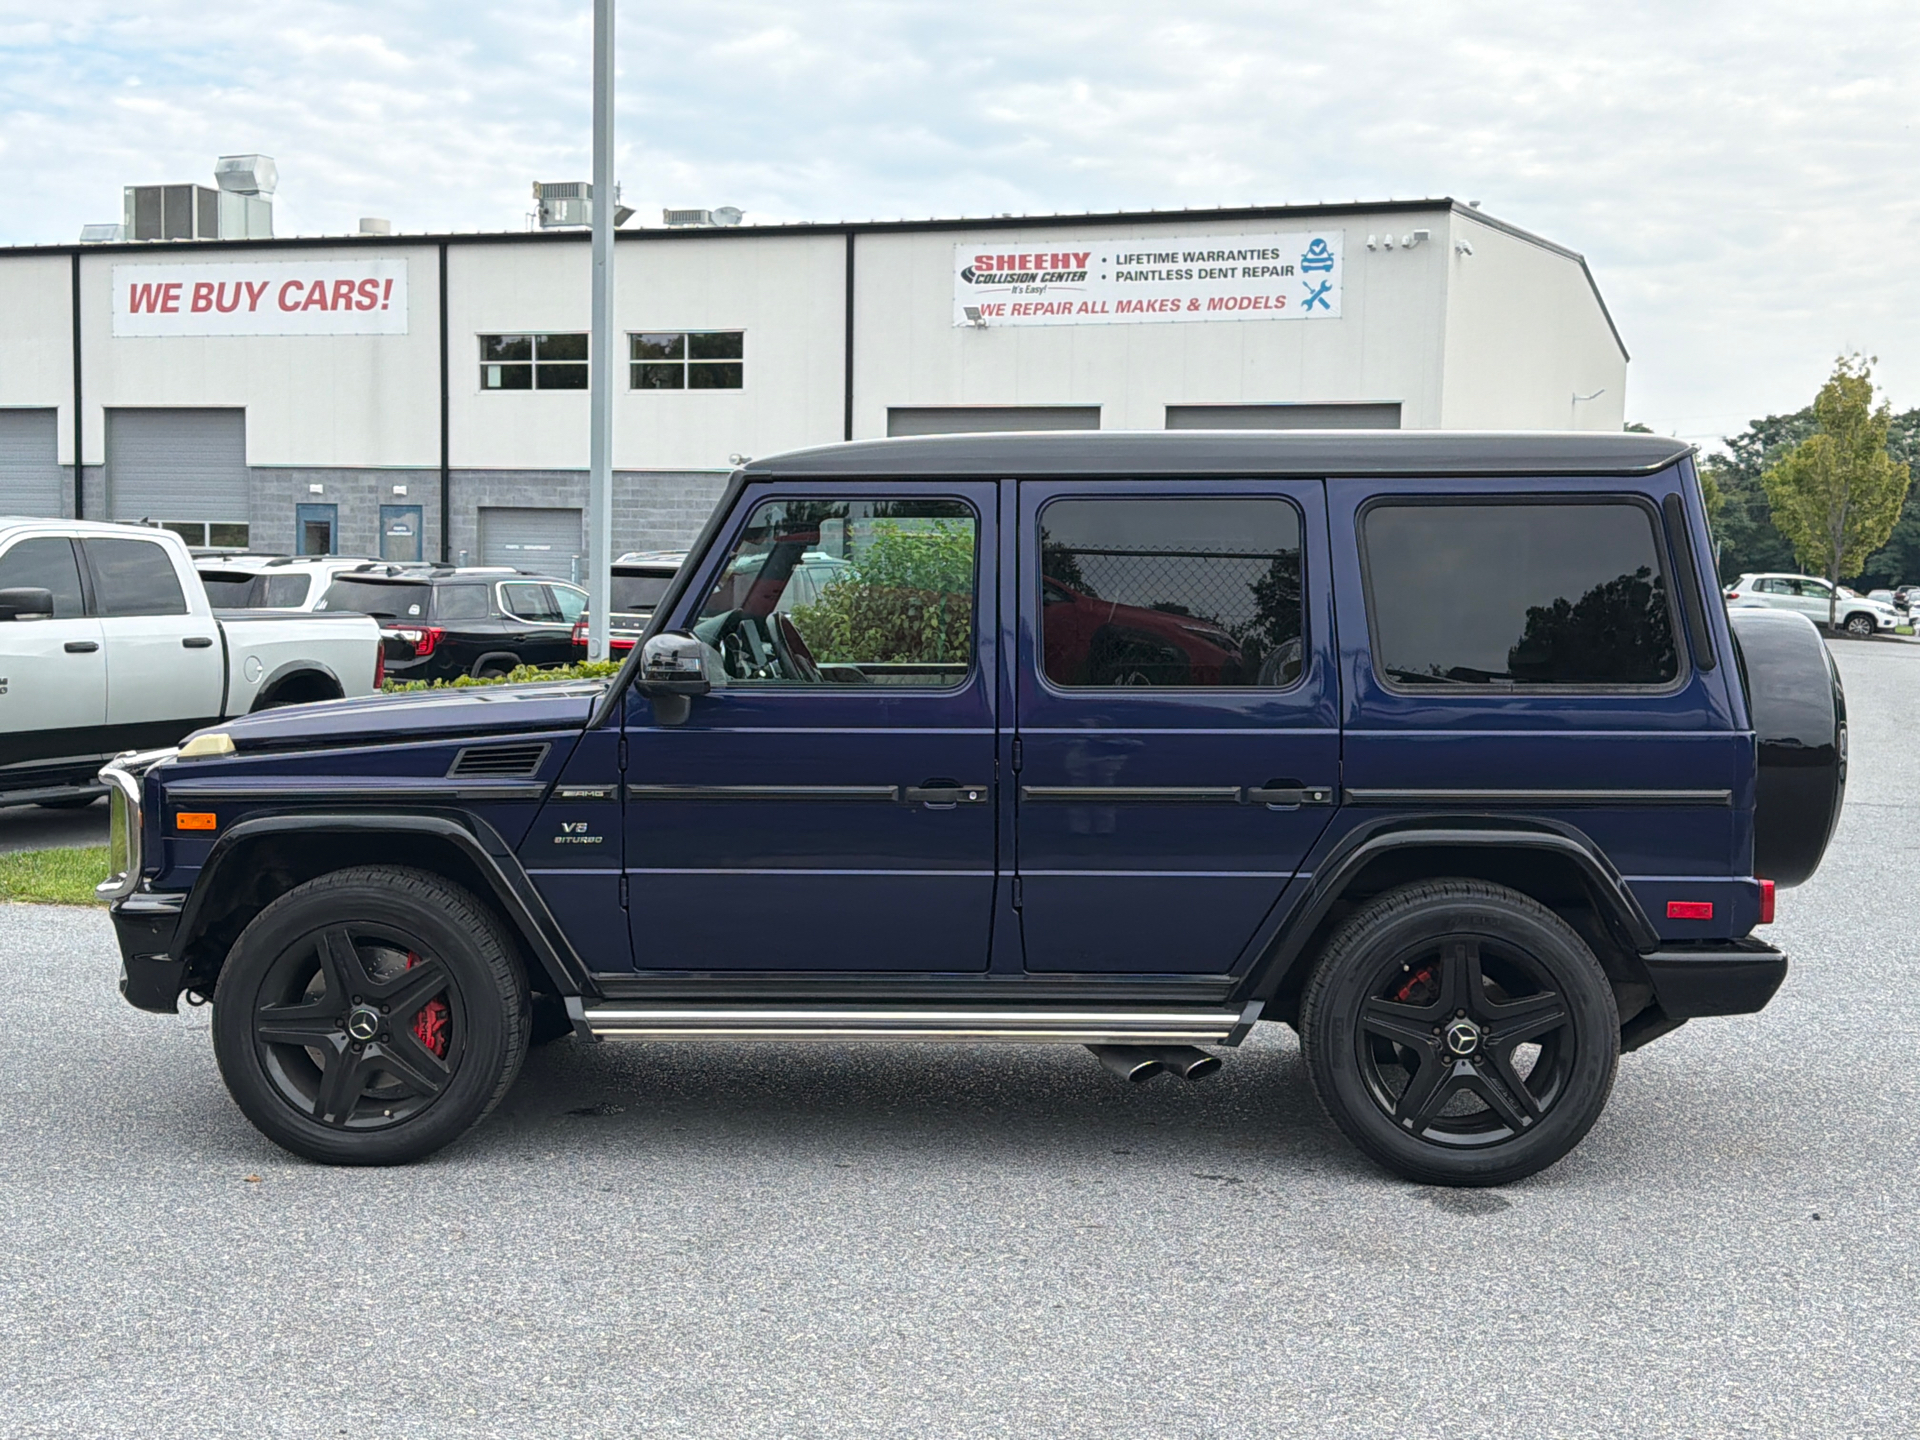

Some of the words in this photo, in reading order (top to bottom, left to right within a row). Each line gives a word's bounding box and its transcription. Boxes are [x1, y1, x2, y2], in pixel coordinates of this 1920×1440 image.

[974, 252, 1091, 271] SHEEHY
[1115, 252, 1179, 265] LIFETIME
[1182, 248, 1280, 263] WARRANTIES
[974, 273, 1038, 285] COLLISION
[1040, 271, 1087, 283] CENTER
[1115, 268, 1193, 282] PAINTLESS
[1198, 267, 1238, 279] DENT
[1242, 265, 1295, 278] REPAIR
[129, 282, 183, 314] WE
[190, 281, 270, 313] BUY
[278, 278, 394, 312] CARS!
[1011, 285, 1023, 294] It's
[1025, 284, 1048, 296] Easy!
[980, 303, 1006, 317] WE
[1010, 301, 1073, 316] REPAIR
[1076, 300, 1109, 315] ALL
[1115, 298, 1181, 313] MAKES
[1186, 297, 1200, 312] &
[1206, 295, 1287, 311] MODELS
[561, 822, 588, 833] V8
[554, 836, 603, 844] BITURBO
